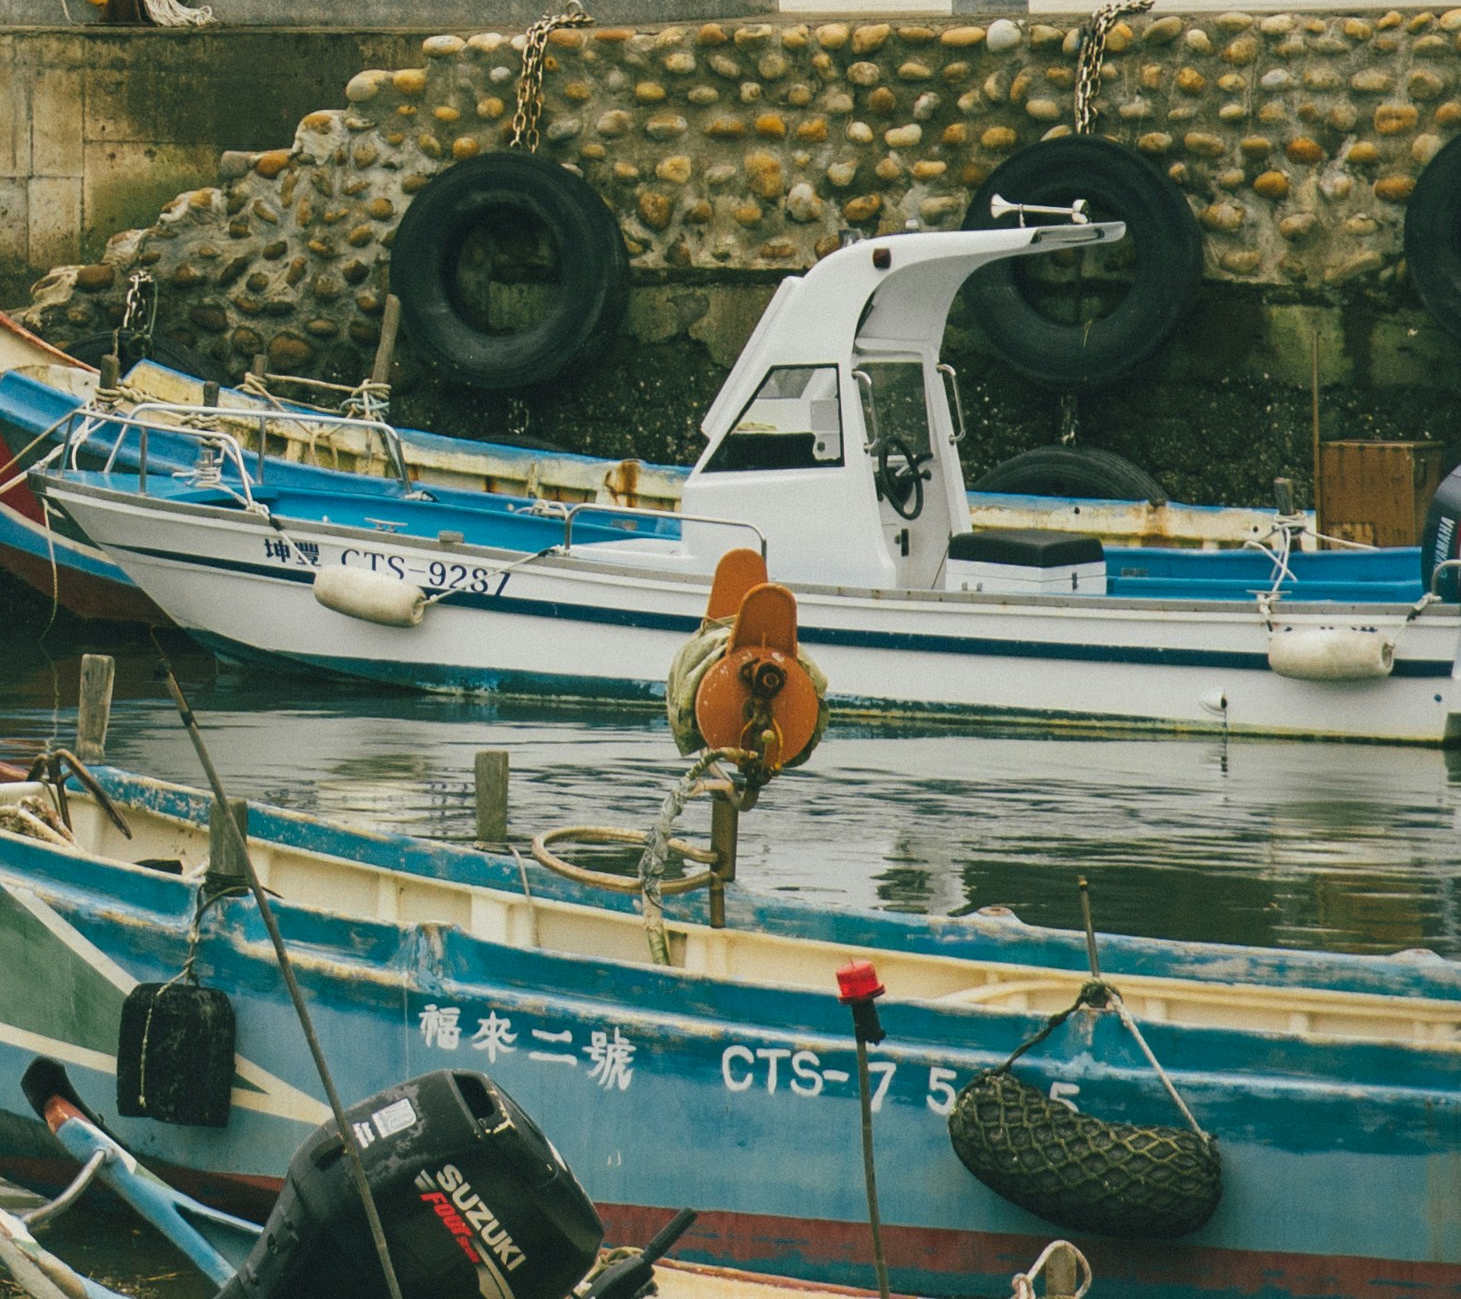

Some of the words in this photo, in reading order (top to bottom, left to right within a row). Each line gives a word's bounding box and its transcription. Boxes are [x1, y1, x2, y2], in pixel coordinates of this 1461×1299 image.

[341, 548, 511, 596] CTS-9287
[1434, 516, 1455, 563] YAMAHA
[418, 1003, 637, 1091] 福來二號
[436, 1164, 527, 1272] SUZUKI
